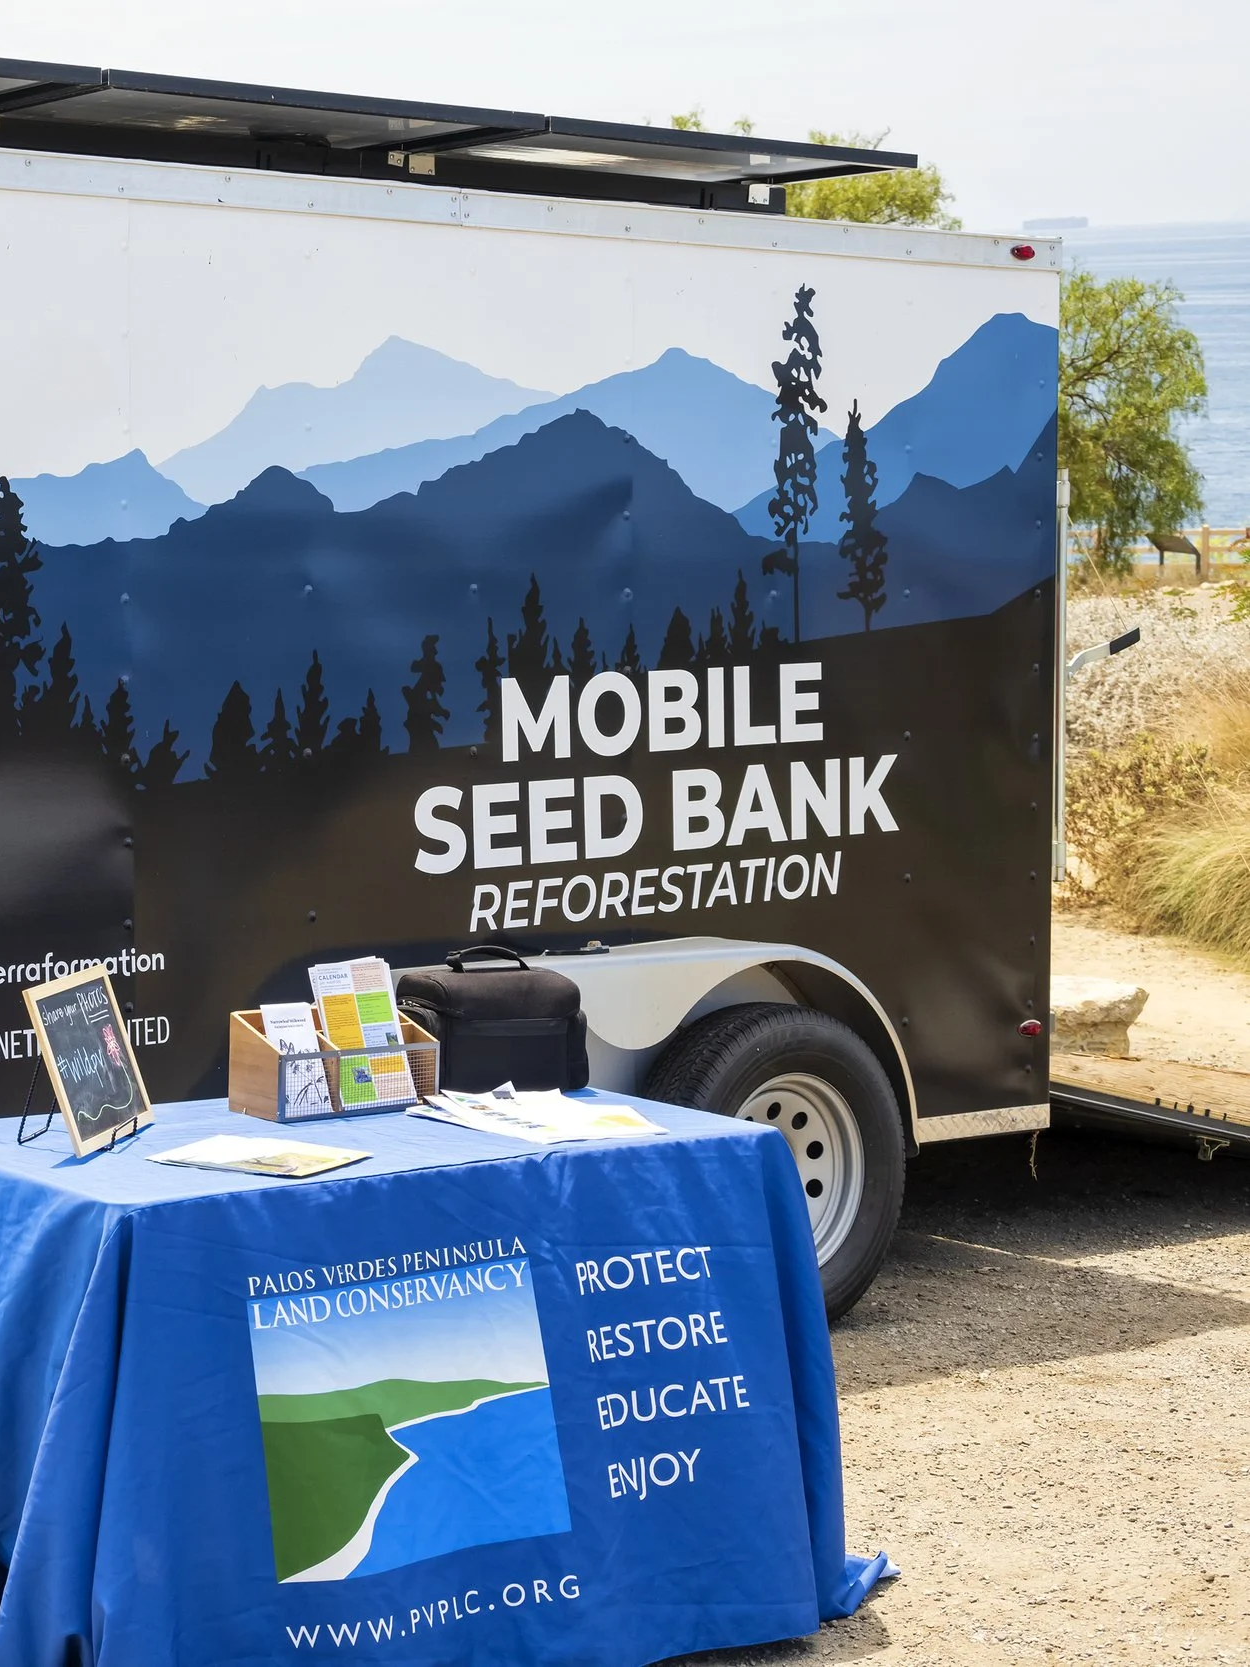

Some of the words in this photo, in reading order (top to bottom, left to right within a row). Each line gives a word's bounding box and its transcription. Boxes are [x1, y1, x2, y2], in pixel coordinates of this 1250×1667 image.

[501, 662, 824, 762] MOBILE
[414, 775, 644, 875] SEED
[672, 754, 900, 852] BANK
[469, 851, 842, 933] REFORESTATION
[63, 1003, 77, 1026] your
[75, 986, 109, 1026] PHOTOS
[318, 973, 349, 981] CALENDAR
[248, 1268, 316, 1297] PALOS
[321, 1256, 397, 1286] VERDES
[402, 1236, 527, 1273] PENINSULA
[252, 1294, 330, 1329] LAND
[335, 1261, 527, 1318] CONSERVANCY
[575, 1246, 711, 1296] PROTECT
[586, 1311, 728, 1363] RESTORE
[596, 1375, 750, 1431] EDUCATE
[607, 1448, 701, 1501] ENJOY
[285, 1574, 581, 1649] WWW.PVPLC.ORG
